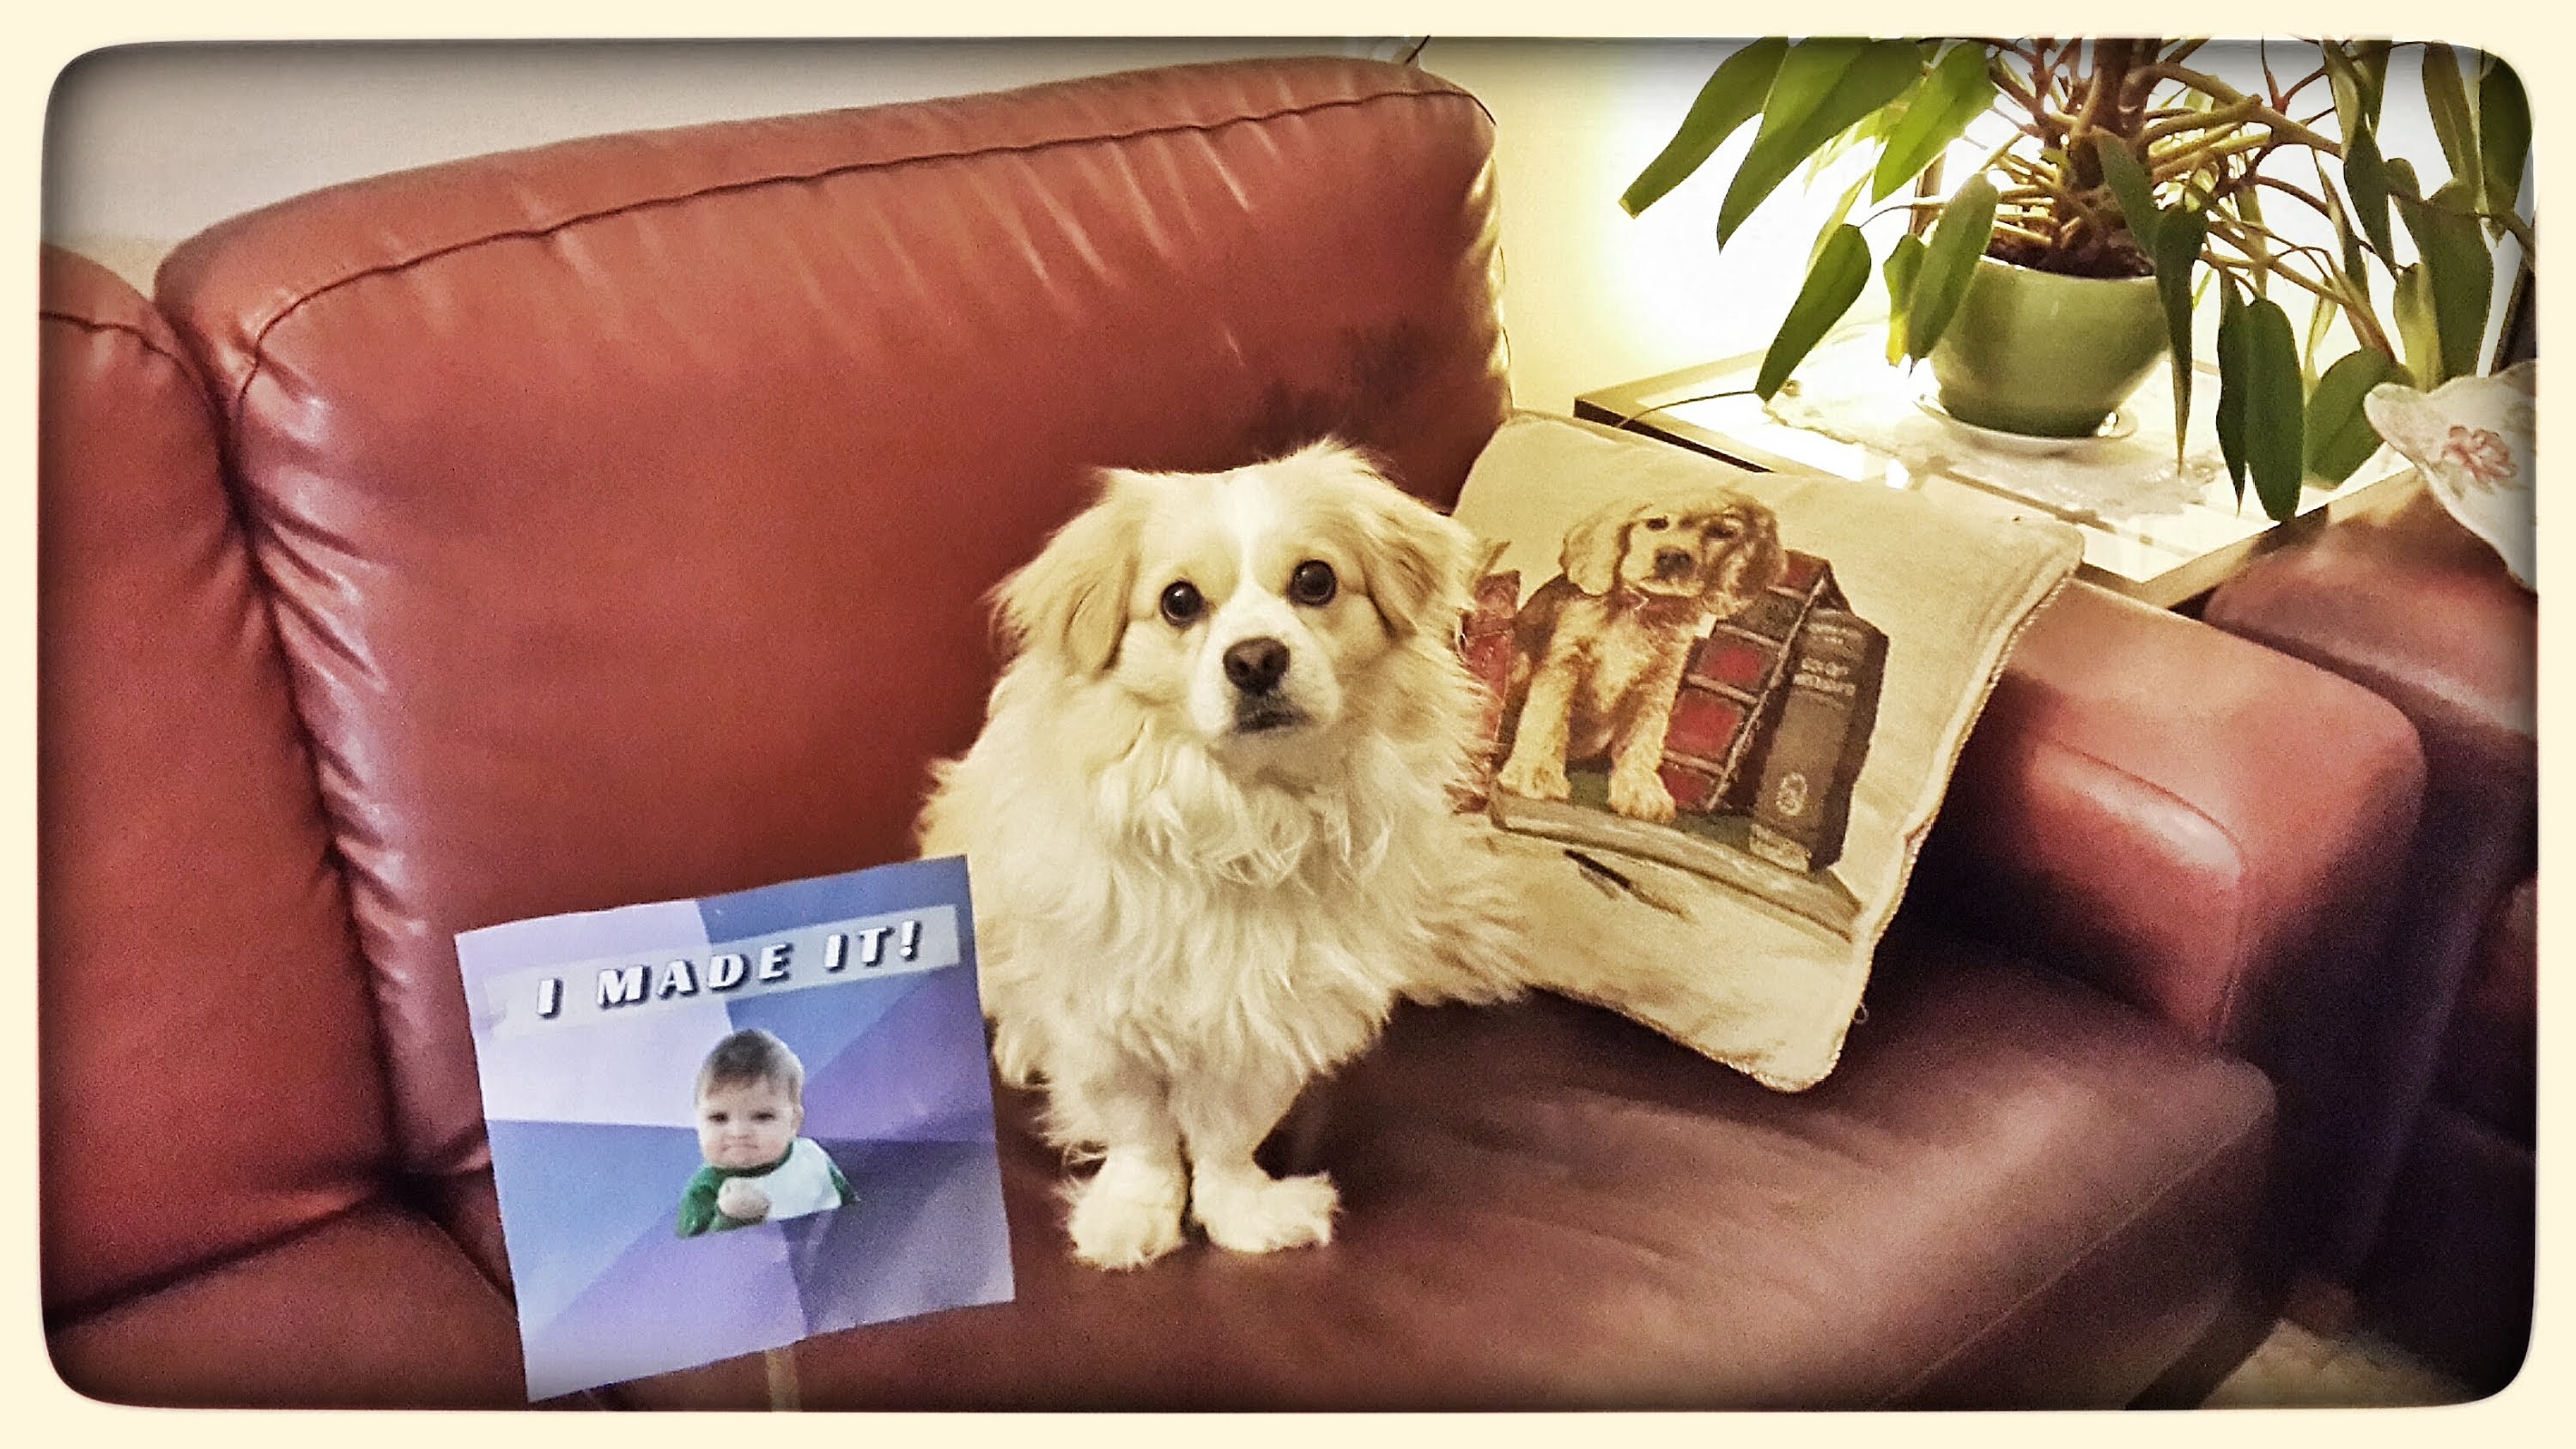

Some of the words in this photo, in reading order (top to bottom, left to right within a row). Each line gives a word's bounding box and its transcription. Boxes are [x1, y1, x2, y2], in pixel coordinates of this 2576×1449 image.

[537, 979, 562, 1017] I
[596, 943, 791, 1008] MADE
[823, 919, 921, 969] IT!
